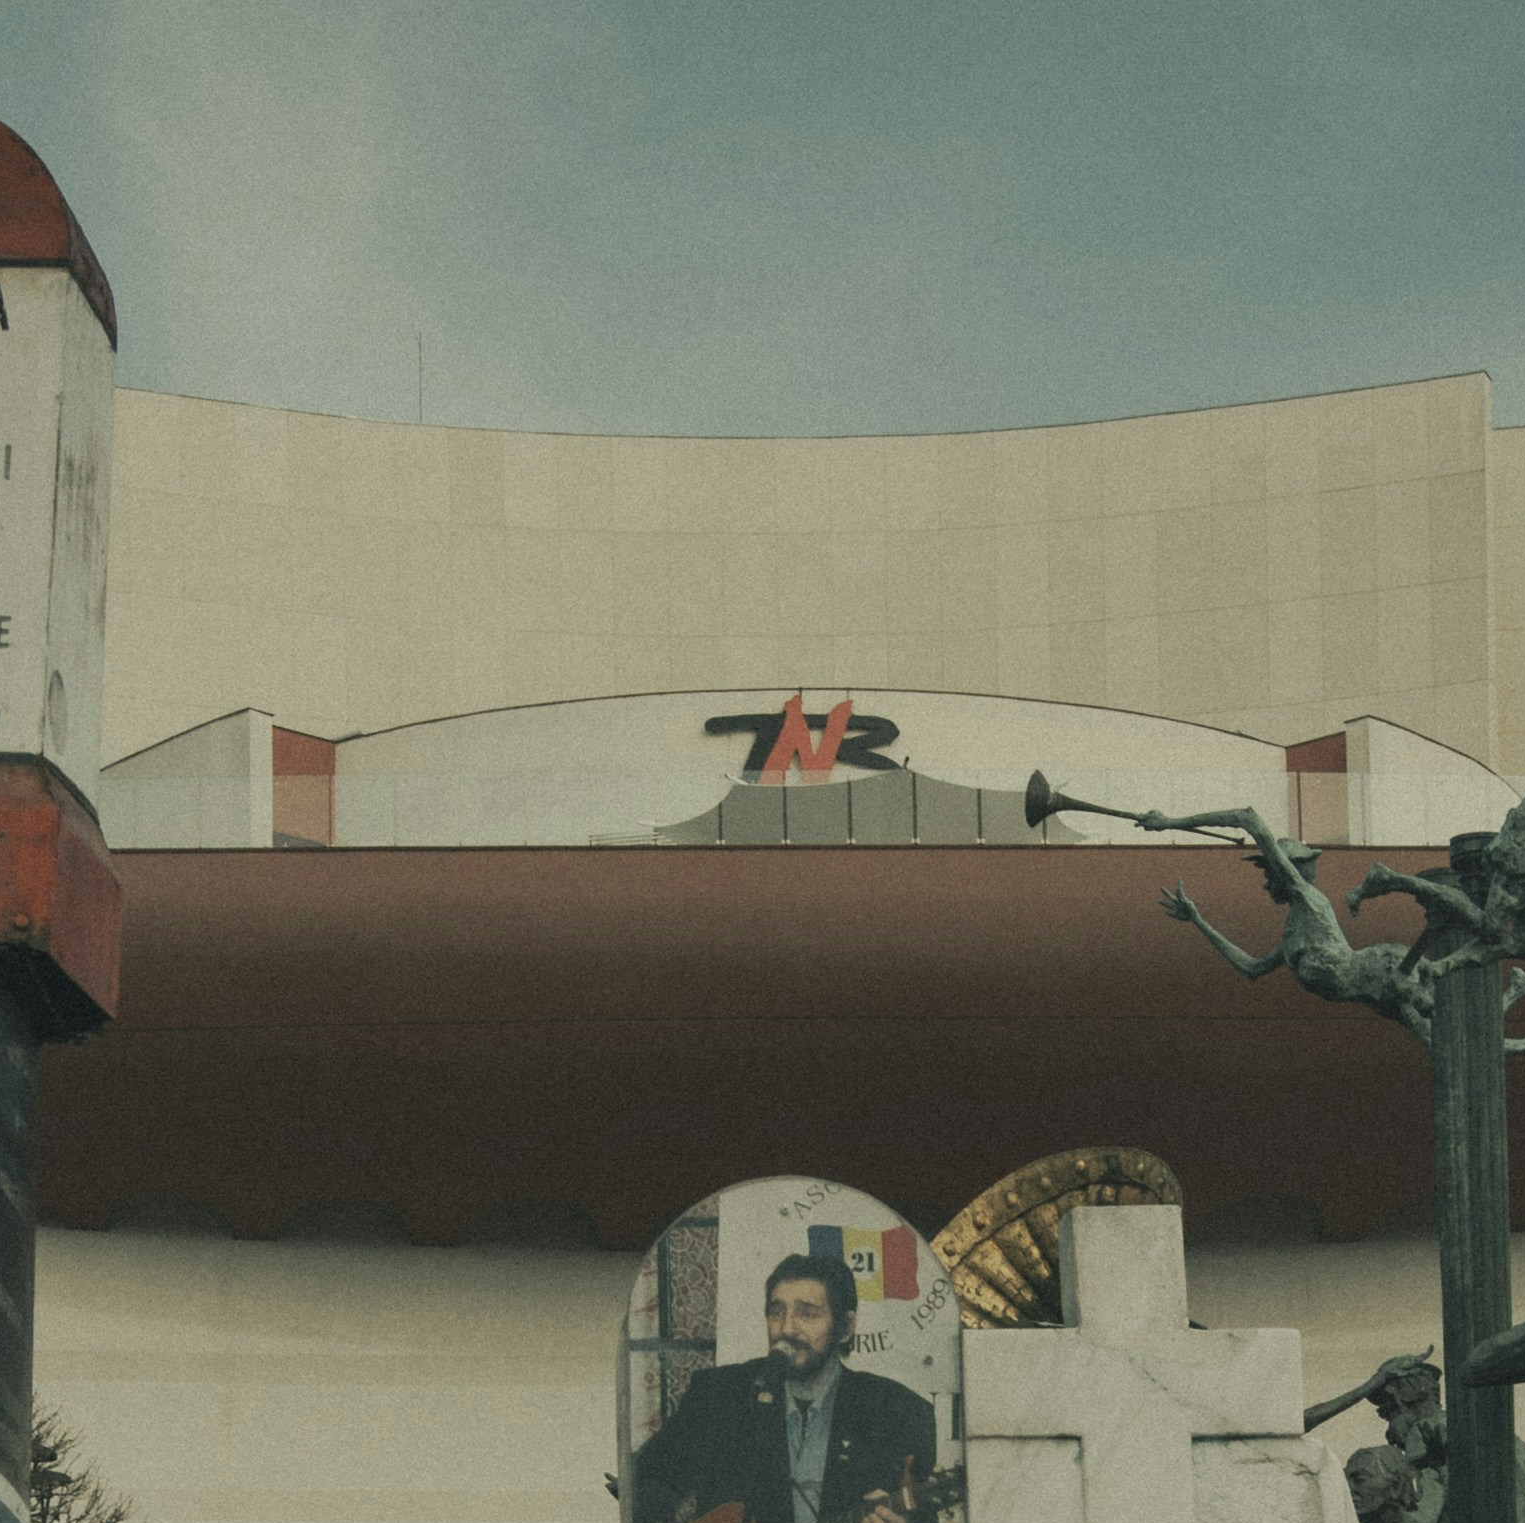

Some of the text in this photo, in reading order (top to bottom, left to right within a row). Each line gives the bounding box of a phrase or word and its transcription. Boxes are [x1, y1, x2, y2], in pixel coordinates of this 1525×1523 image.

[851, 1252, 874, 1273] 21
[911, 1278, 951, 1331] 1989
[854, 1330, 893, 1353] RIE
